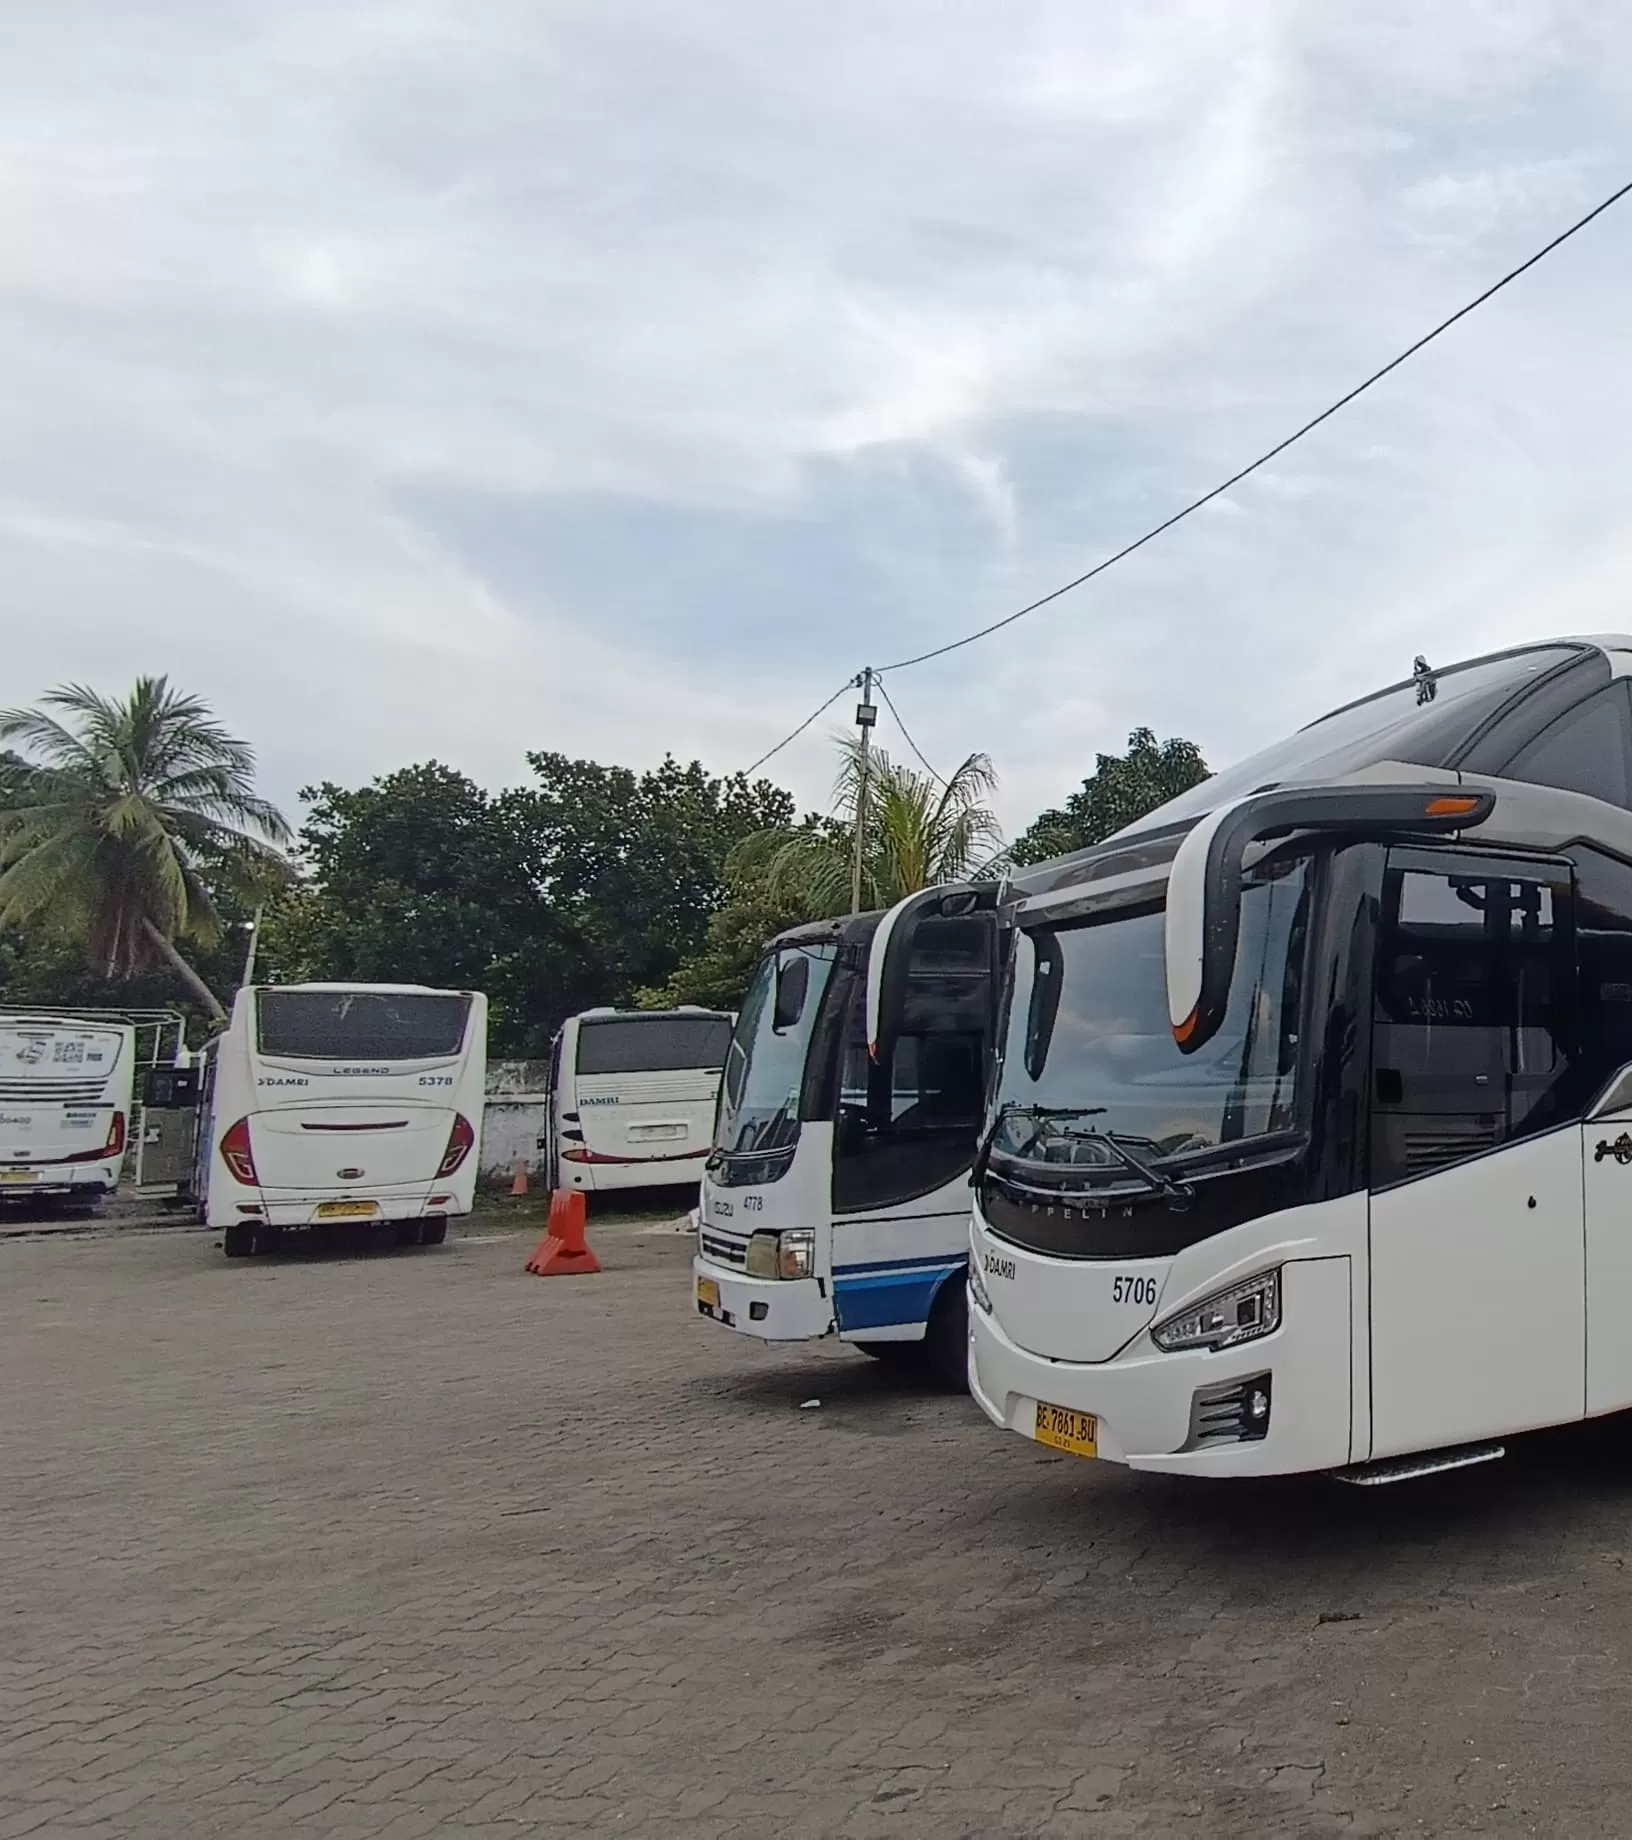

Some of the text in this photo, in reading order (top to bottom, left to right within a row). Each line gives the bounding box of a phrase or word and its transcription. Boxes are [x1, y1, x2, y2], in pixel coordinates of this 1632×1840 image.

[267, 1078, 309, 1086] DAMRI
[418, 1077, 453, 1086] 5378
[580, 1097, 619, 1106] DAMRI
[989, 1257, 1015, 1280] DAMRI
[1112, 1276, 1157, 1305] 5706
[1052, 1409, 1075, 1438] 7861
